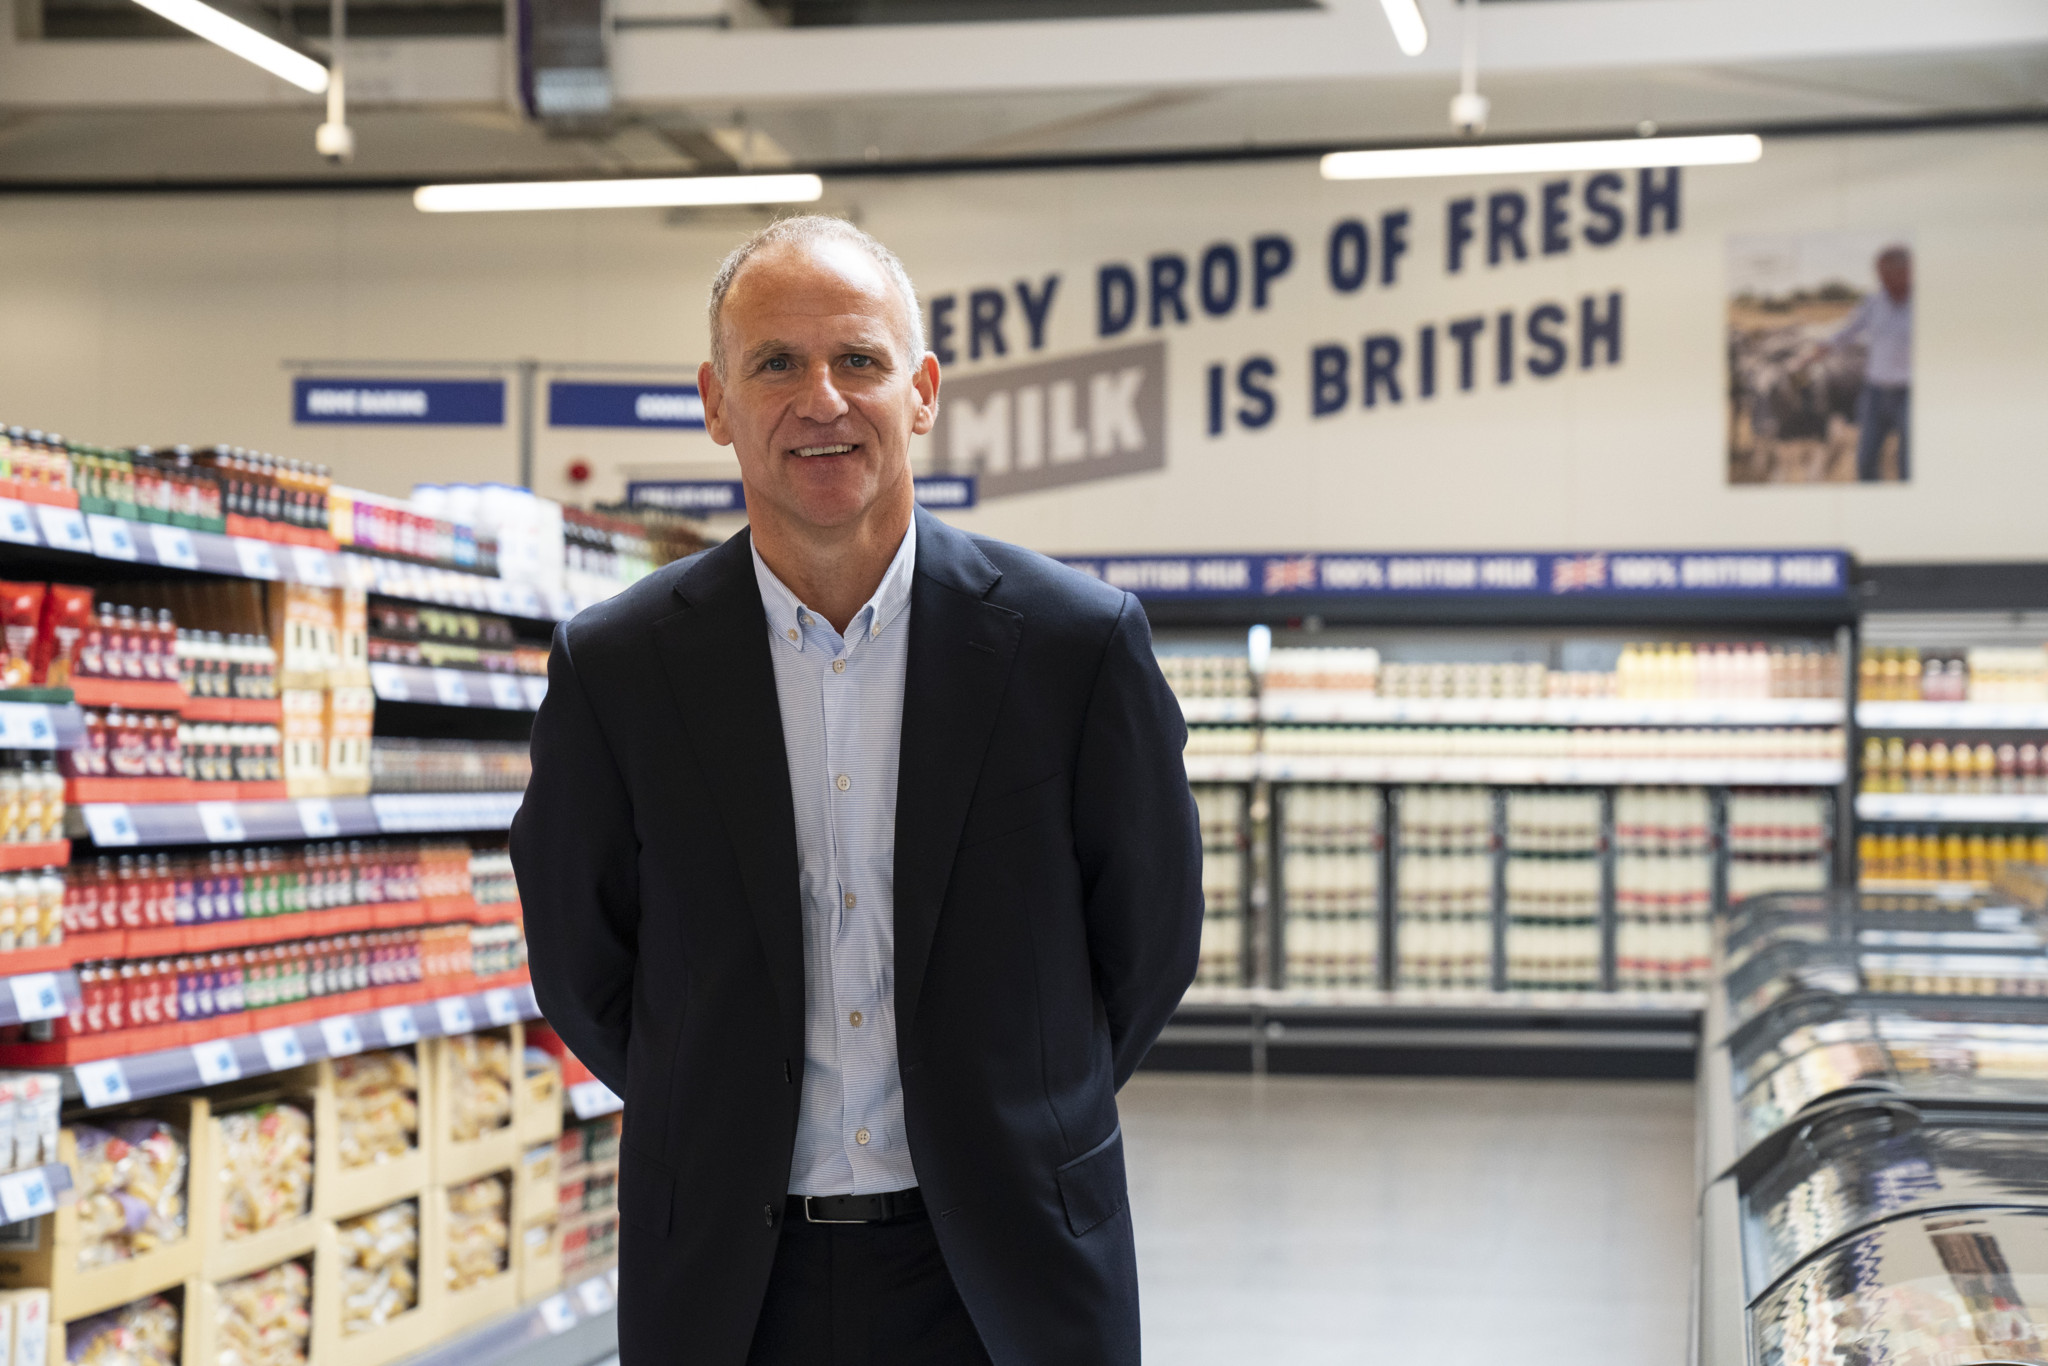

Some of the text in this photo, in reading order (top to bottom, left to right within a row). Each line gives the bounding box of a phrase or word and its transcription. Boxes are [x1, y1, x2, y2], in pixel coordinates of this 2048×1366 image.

[930, 166, 1682, 367] ERY DROP OF FRESH
[950, 289, 1624, 477] MILK IS BRITISH
